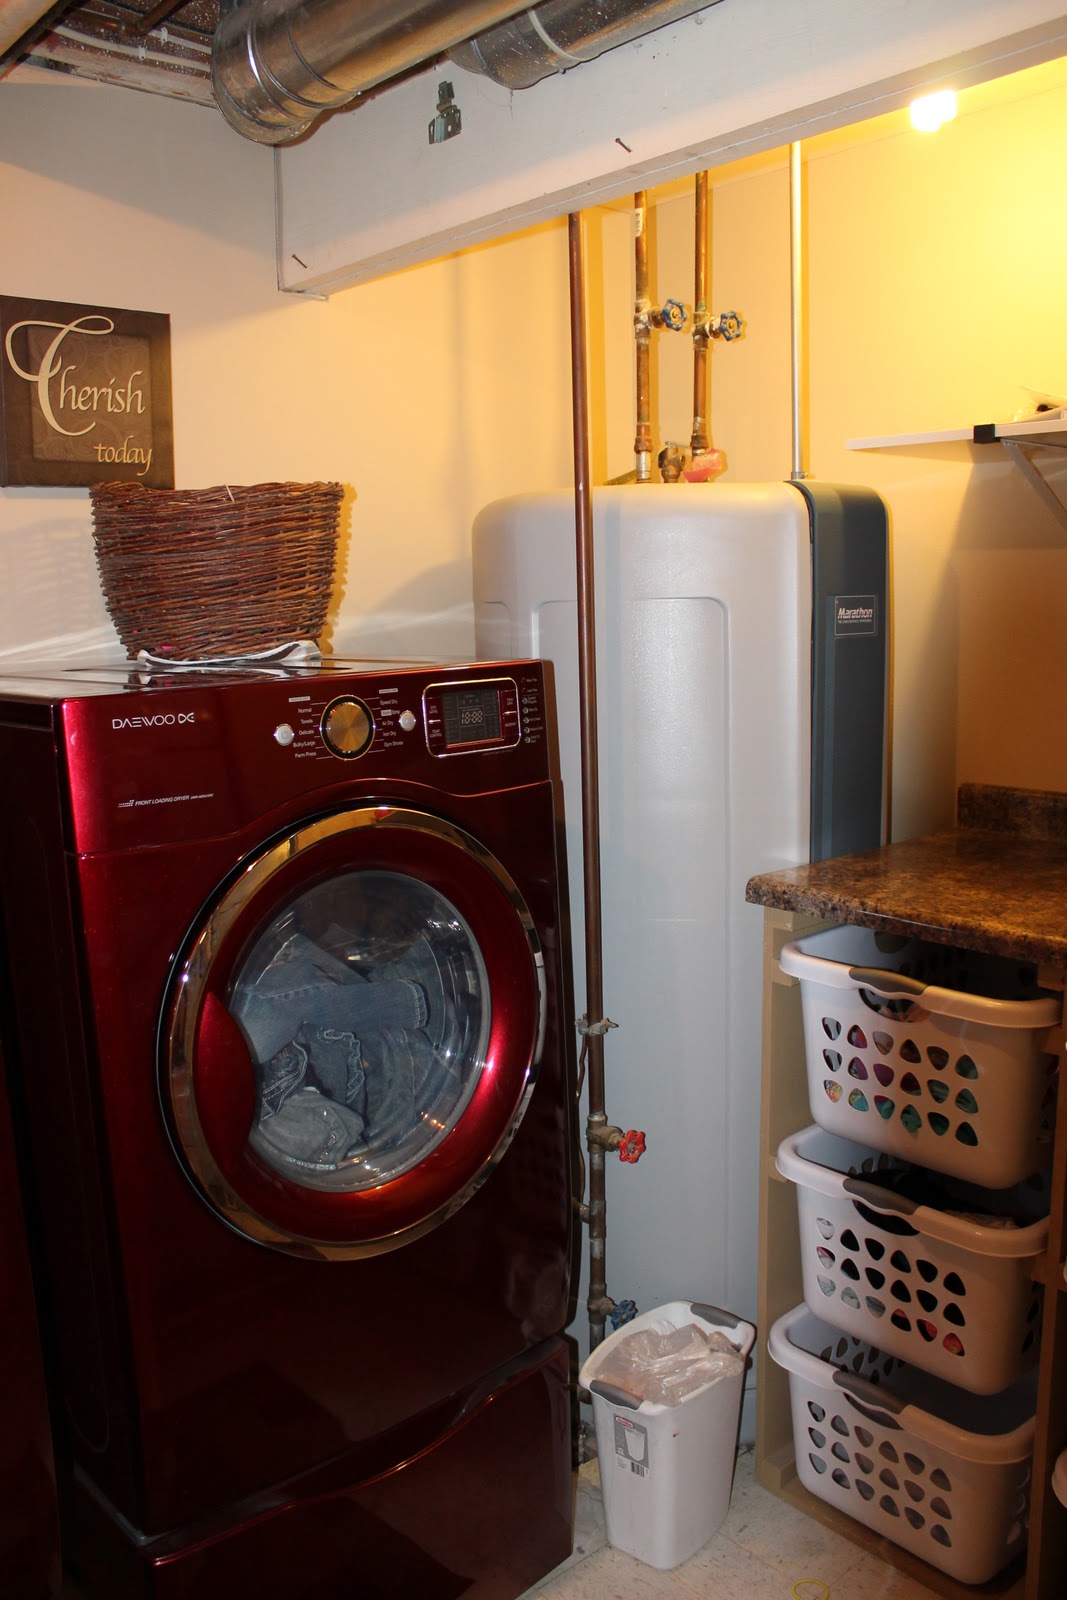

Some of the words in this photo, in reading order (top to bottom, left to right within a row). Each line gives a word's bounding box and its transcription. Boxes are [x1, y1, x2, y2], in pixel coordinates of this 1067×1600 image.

[5, 315, 146, 436] Cherish
[93, 435, 153, 476] today
[838, 607, 873, 619] Marathon
[112, 714, 176, 730] DAEWOO
[151, 796, 173, 804] LOADING
[173, 794, 190, 802] DRYER
